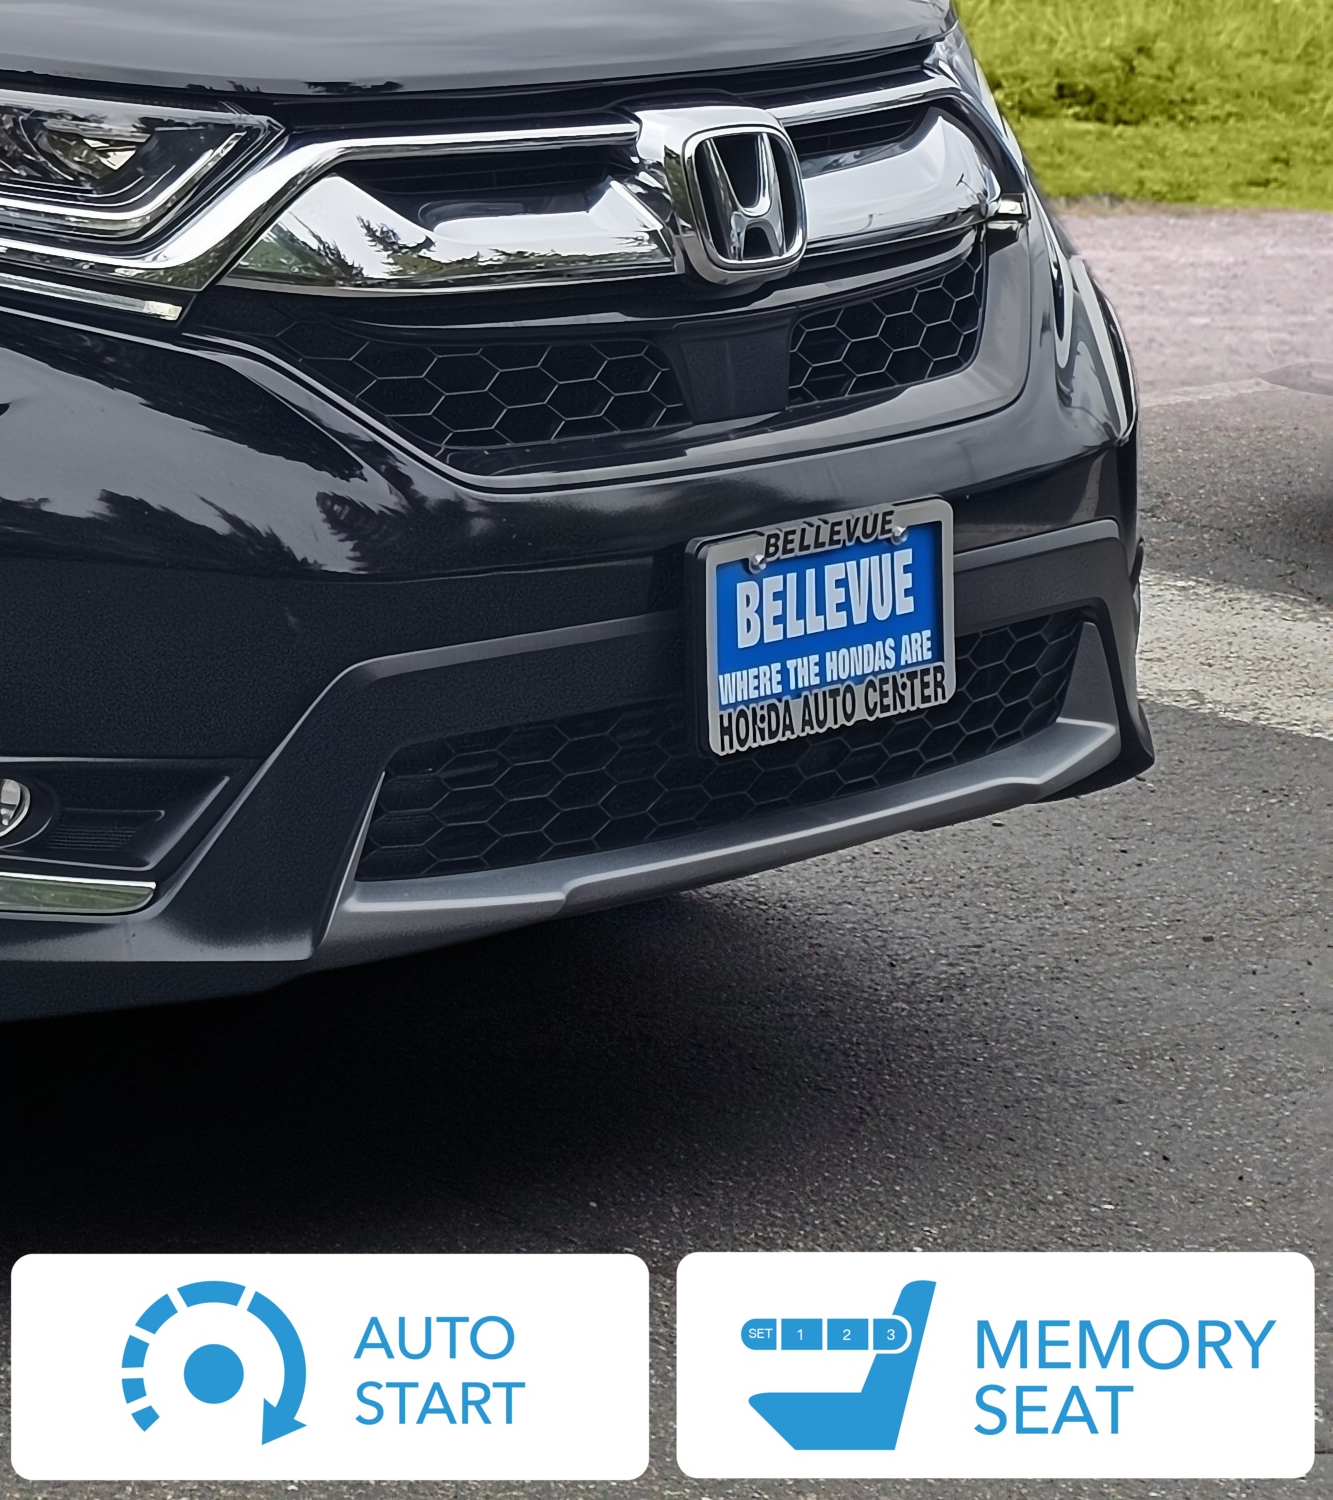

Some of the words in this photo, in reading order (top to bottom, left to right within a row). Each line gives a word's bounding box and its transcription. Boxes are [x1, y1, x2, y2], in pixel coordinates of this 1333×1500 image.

[764, 510, 895, 559] BELLEVUE
[736, 548, 915, 649] BELLEVUE
[718, 662, 783, 706] WHERE
[786, 654, 821, 690] THE
[825, 637, 896, 683] HONDAS
[900, 629, 933, 666] ARE
[719, 699, 796, 754] HONDA
[801, 683, 857, 735] AUTO
[864, 665, 947, 718] CENTER
